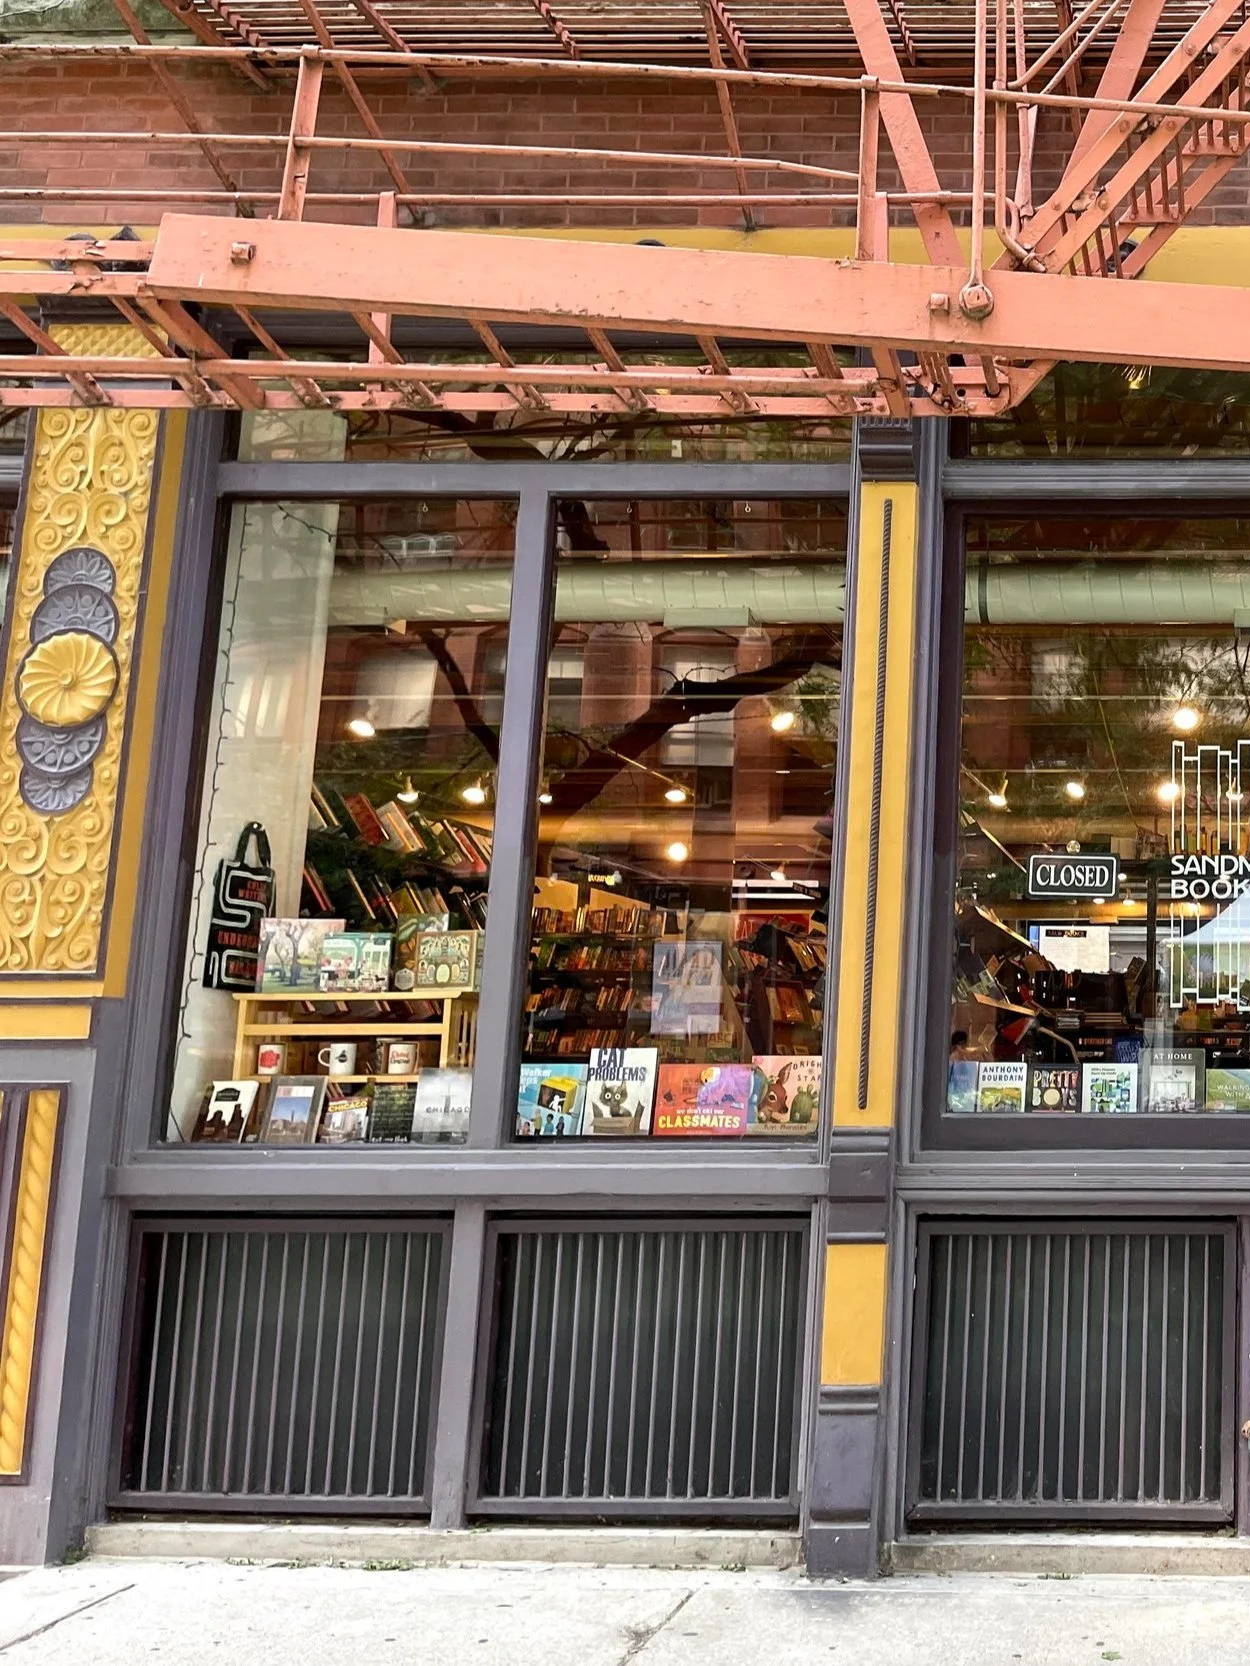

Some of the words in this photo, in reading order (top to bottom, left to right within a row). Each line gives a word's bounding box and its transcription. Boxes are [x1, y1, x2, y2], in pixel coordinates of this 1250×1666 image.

[1036, 863, 1109, 887] CLOSED
[597, 1048, 626, 1069] CAT
[792, 1060, 822, 1071] BRIGH
[588, 1066, 647, 1082] PROBLEMS
[983, 1066, 1024, 1074] ANTHONY
[981, 1074, 1024, 1082] BOURDAIN
[1033, 1070, 1079, 1088] PRETTY
[1031, 1087, 1078, 1106] BOYS
[328, 1101, 368, 1113] CHICAGO
[658, 1114, 741, 1129] CLASSMATES
